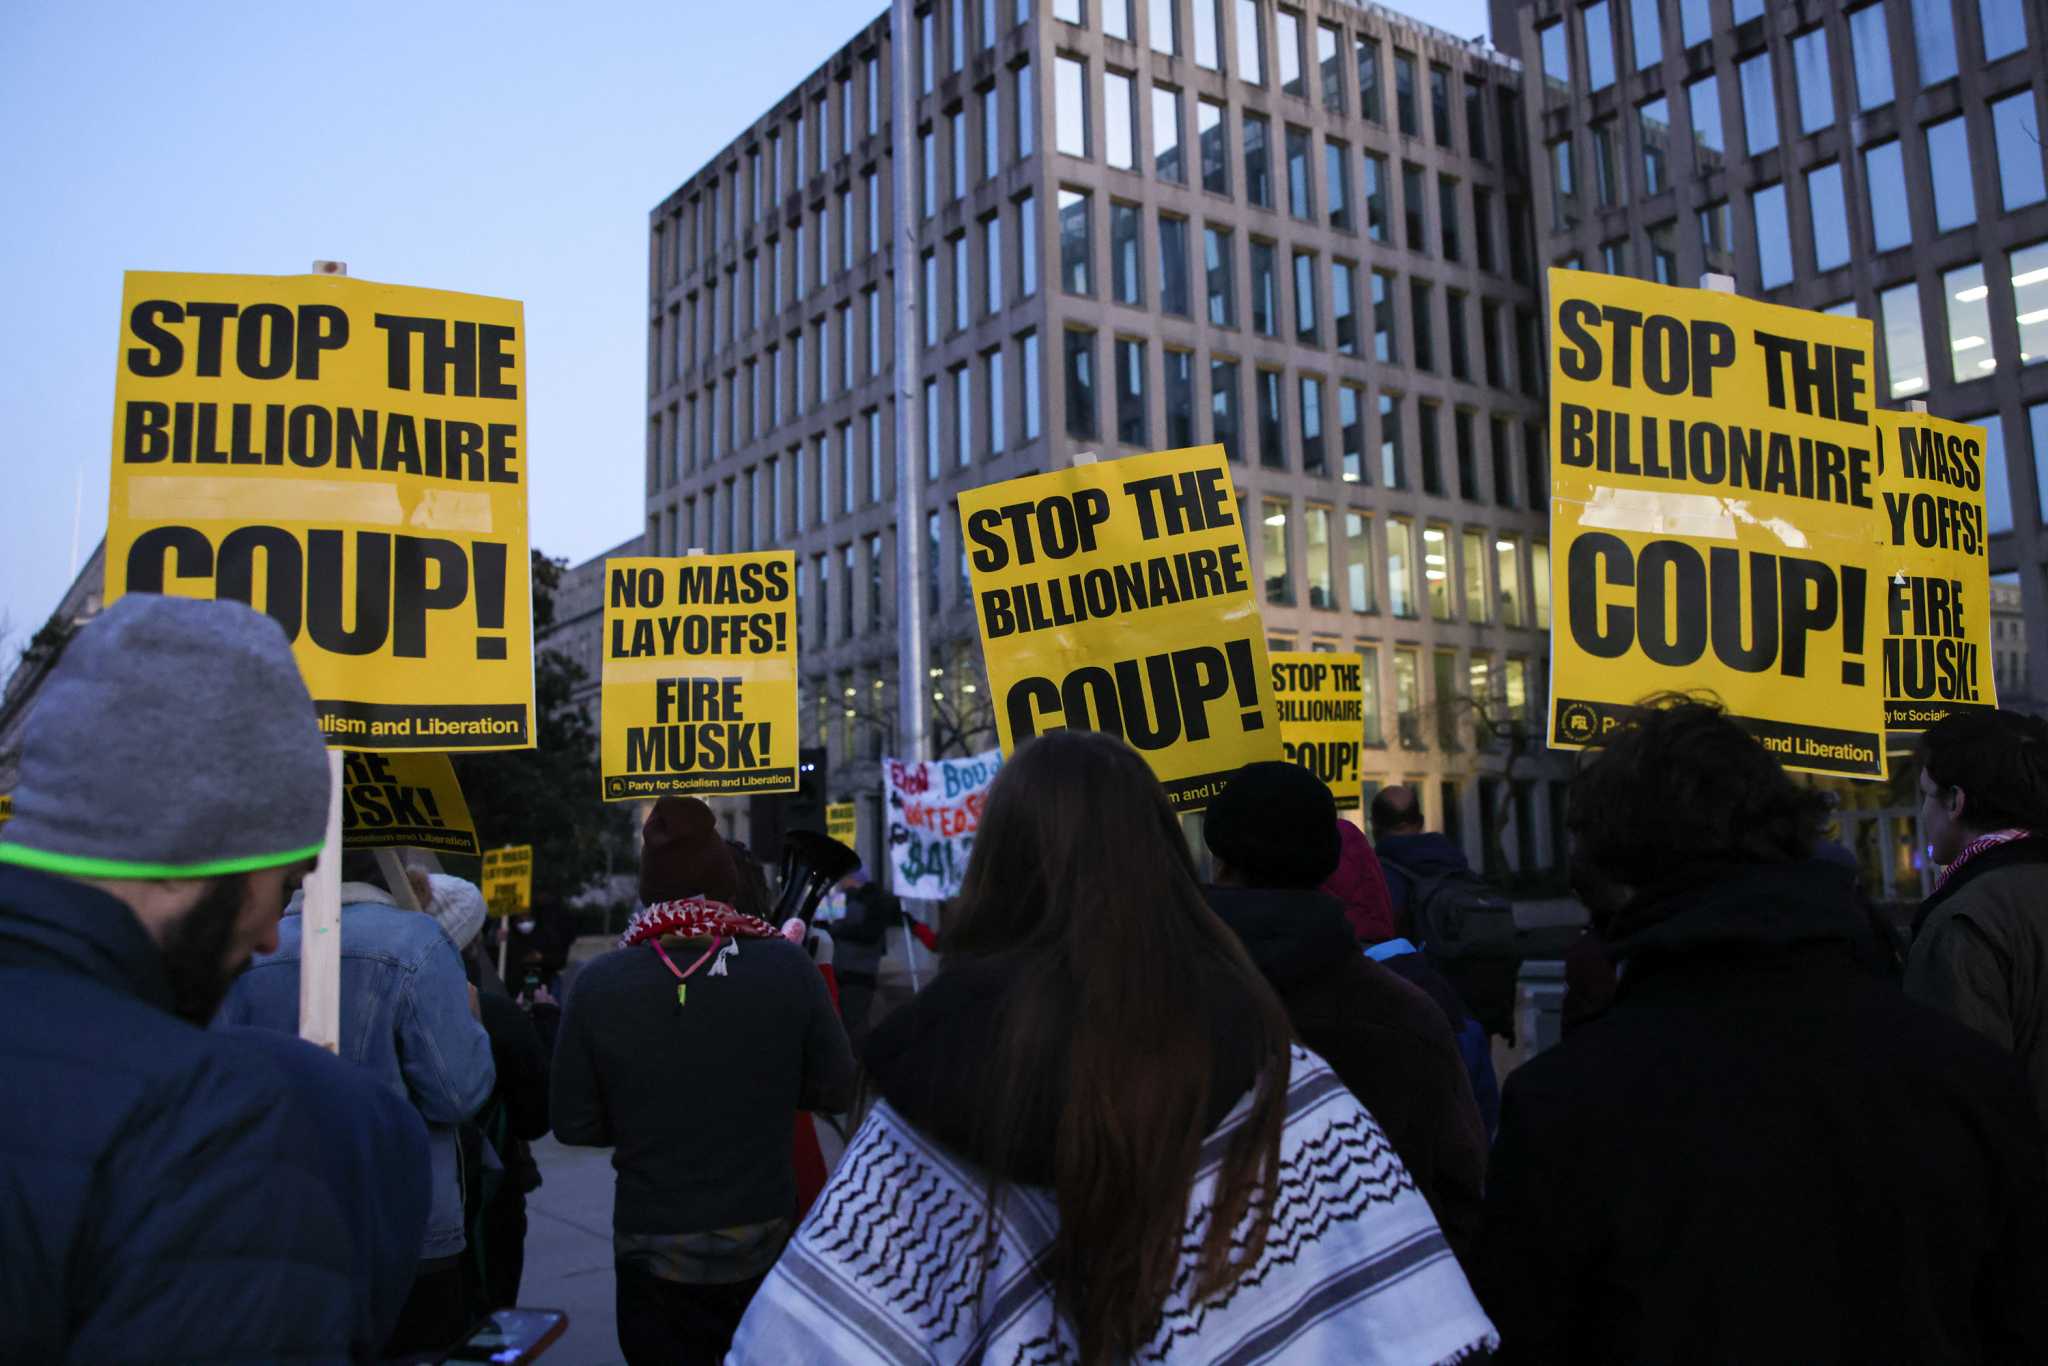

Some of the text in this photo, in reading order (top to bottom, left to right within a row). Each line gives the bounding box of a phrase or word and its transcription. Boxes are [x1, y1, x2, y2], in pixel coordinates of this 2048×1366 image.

[127, 299, 518, 400] STOP THE
[1558, 298, 1869, 427] STOP THE
[123, 401, 519, 484] BILLIONAIRE
[1560, 402, 1874, 510] BILLIONAIRE
[1898, 427, 1981, 492] MASS
[967, 467, 1235, 573] STOP THE
[126, 525, 507, 660] COUP!
[611, 560, 789, 608] NO MASS
[980, 544, 1249, 640] BILLIONAIRE
[1567, 531, 1868, 687] COUP!
[1888, 575, 1966, 638] FIRE
[611, 612, 787, 658] LAYOFFS!
[656, 676, 744, 724] FIRE
[1006, 638, 1265, 761] COUP!
[1271, 662, 1361, 692] STOP THE
[371, 718, 411, 735] and
[416, 716, 519, 735] Liberation
[1276, 700, 1362, 722] BILLIONAIRE
[1893, 709, 1907, 721] for
[626, 722, 771, 773] MUSK!
[1763, 734, 1791, 753] and
[1795, 738, 1874, 763] Liberation
[628, 781, 654, 793] Party
[656, 778, 670, 790] for
[672, 777, 720, 789] Socialism
[721, 776, 741, 787] and
[742, 774, 792, 786] Liberation
[1183, 785, 1209, 801] and
